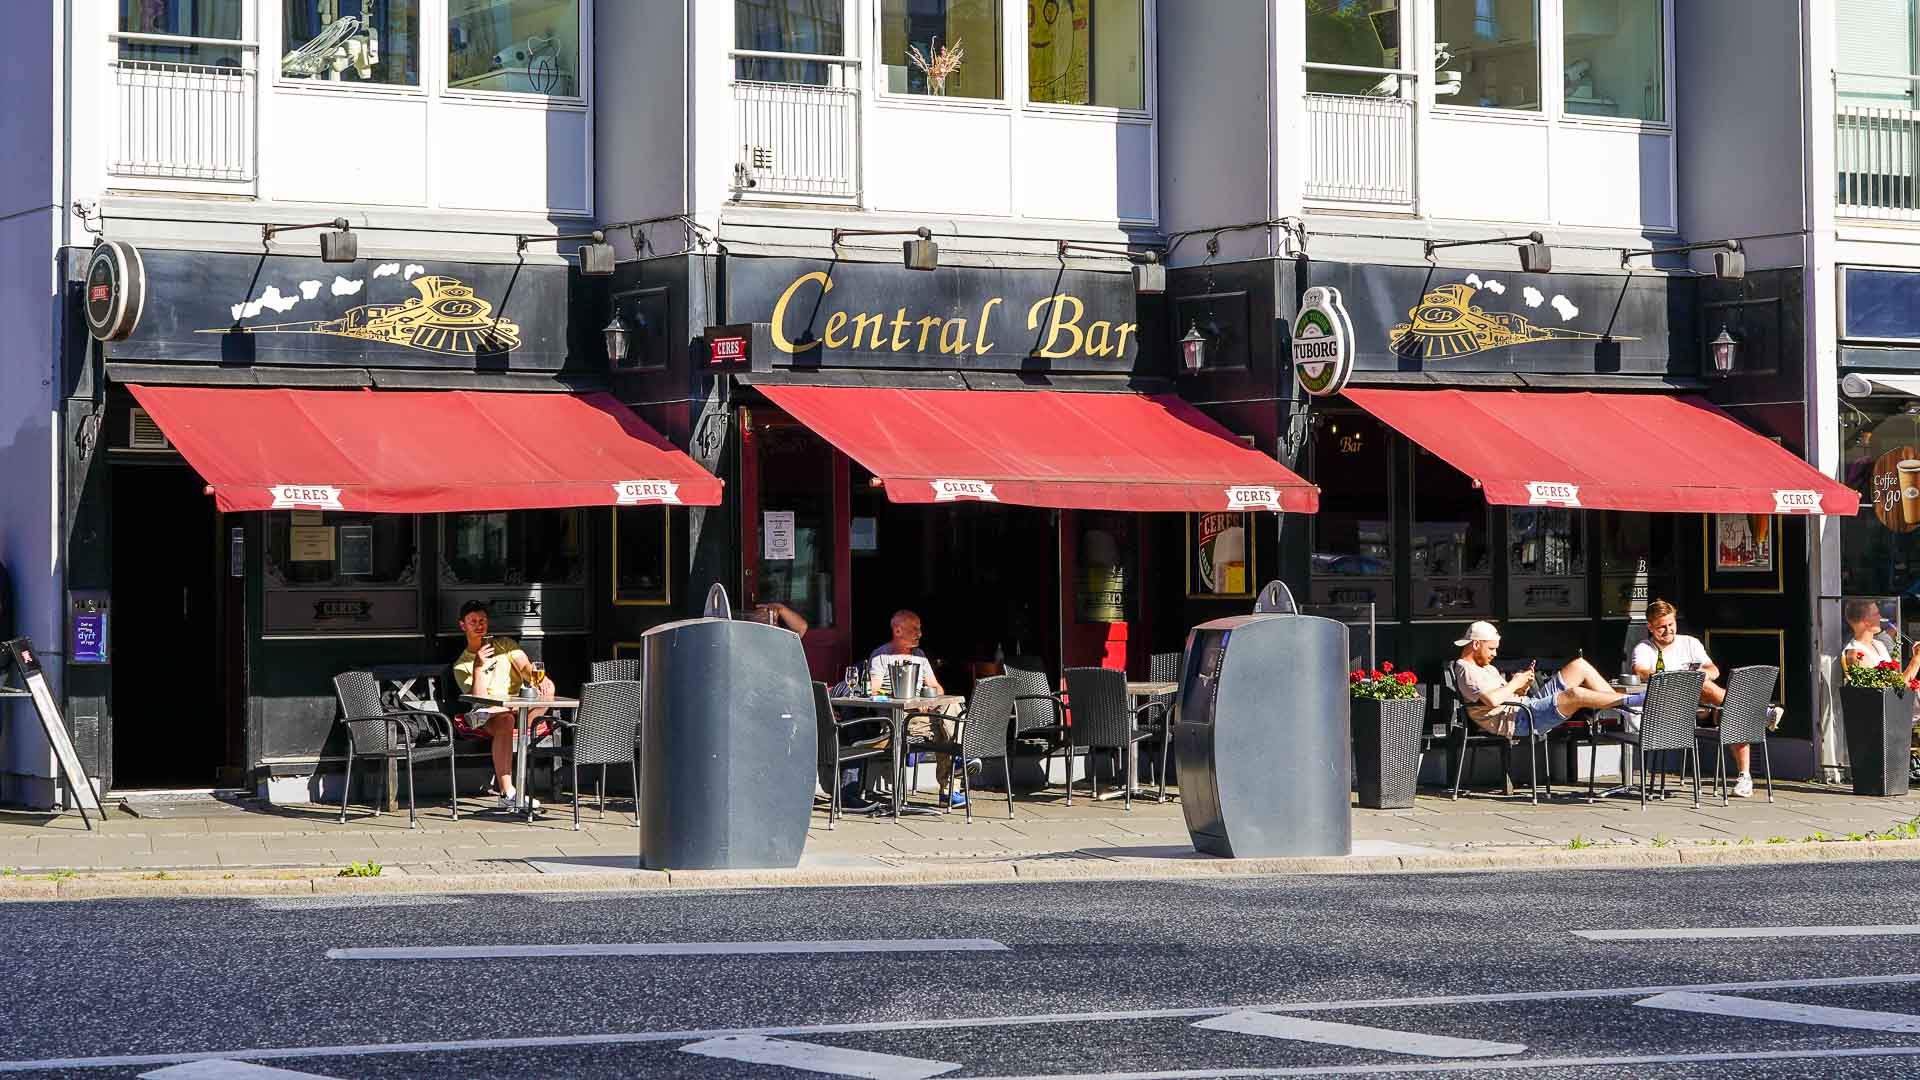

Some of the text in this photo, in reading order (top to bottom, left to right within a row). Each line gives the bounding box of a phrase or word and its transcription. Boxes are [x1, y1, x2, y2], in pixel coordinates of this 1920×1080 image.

[440, 300, 473, 316] CB
[770, 271, 1138, 358] Central Bar
[1424, 308, 1454, 322] CB
[717, 341, 740, 355] CERES
[1293, 341, 1337, 359] TUBORG
[943, 482, 984, 493] CERES
[1873, 472, 1898, 490] Coffee
[283, 488, 329, 500] CERES
[626, 484, 668, 496] CERES
[1235, 490, 1271, 502] CERES
[1536, 486, 1570, 498] CERES
[1782, 494, 1814, 505] CERES
[1873, 490, 1901, 511] 2 go
[78, 632, 97, 641] dyrt
